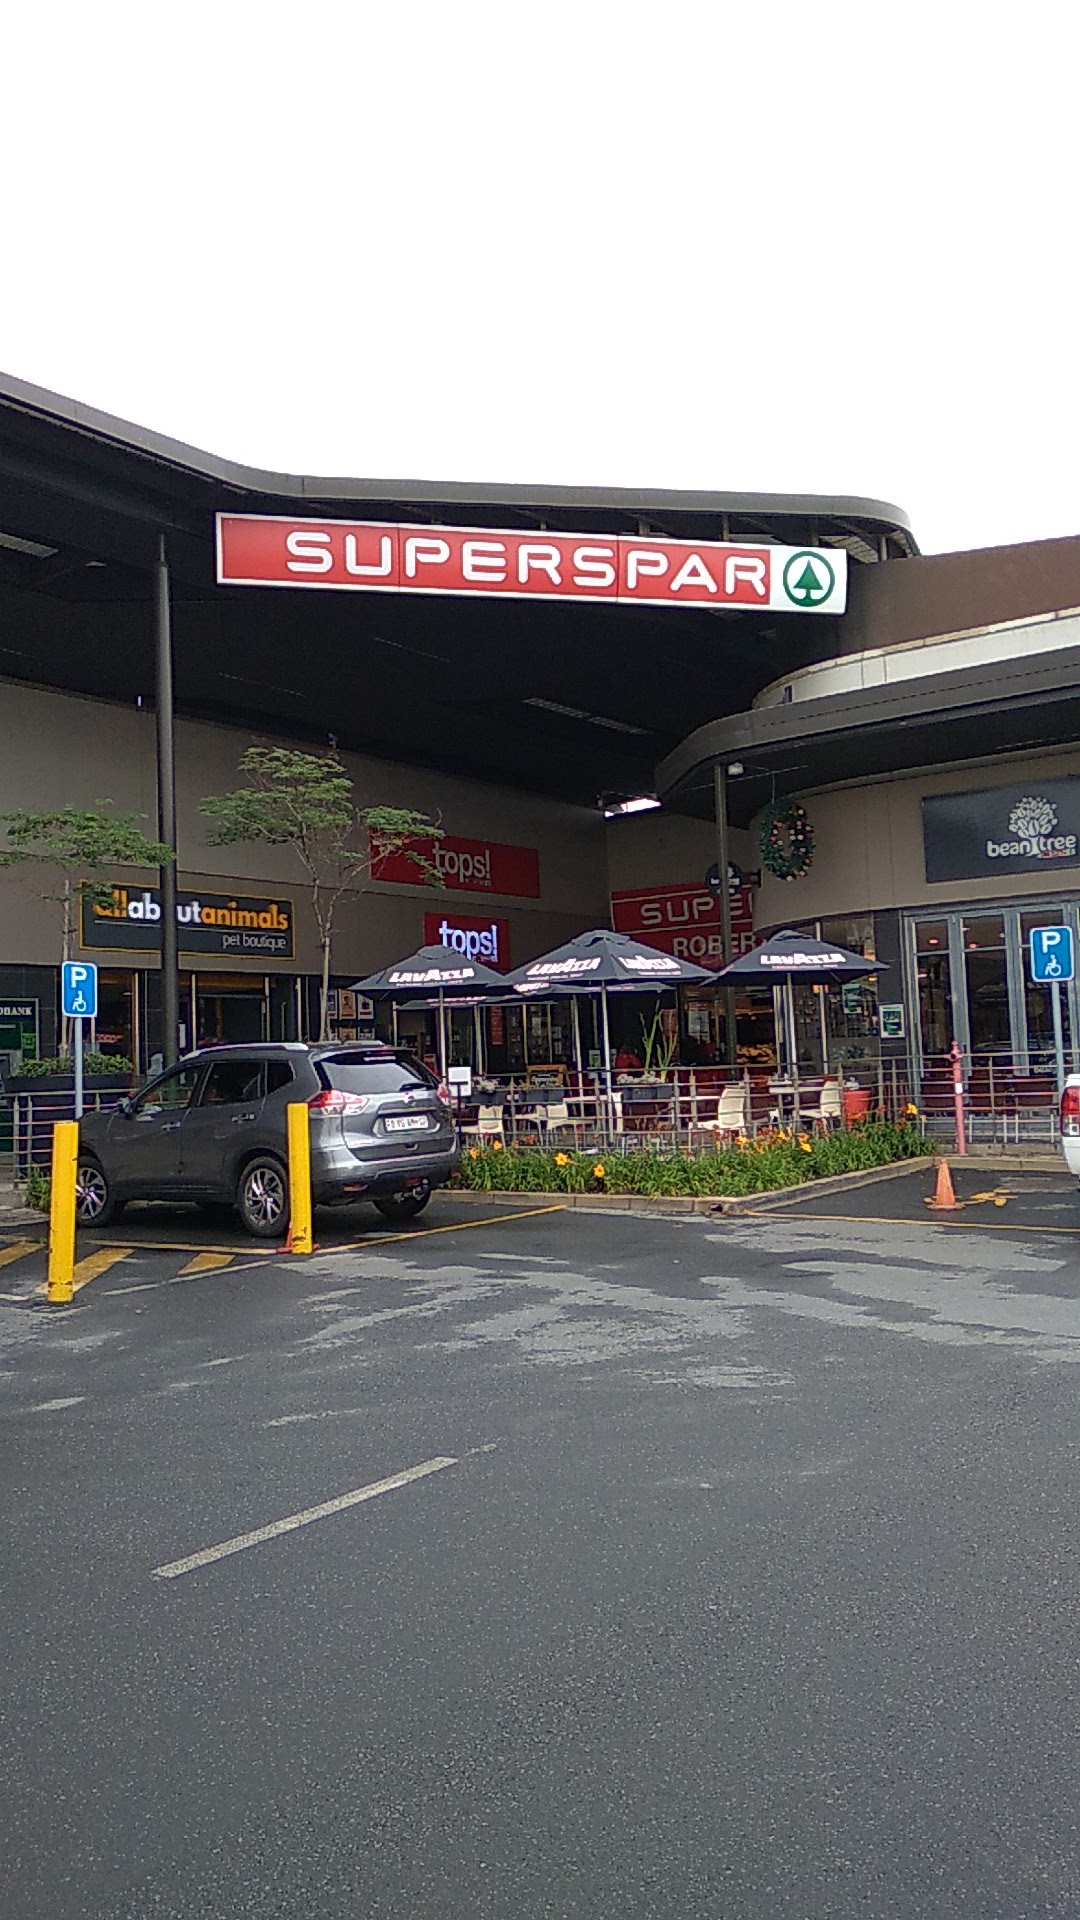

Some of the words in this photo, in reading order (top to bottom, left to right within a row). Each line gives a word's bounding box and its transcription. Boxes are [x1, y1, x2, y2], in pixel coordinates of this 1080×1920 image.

[285, 531, 767, 596] SUPERSPAR
[986, 840, 1031, 858] bean
[1039, 835, 1077, 851] tree
[432, 841, 491, 883] tops!
[640, 892, 753, 925] SUPE
[222, 934, 240, 949] pet
[438, 920, 498, 962] tops!
[1041, 931, 1061, 953] P
[70, 966, 88, 989] P
[388, 967, 475, 983] LAVAZZA
